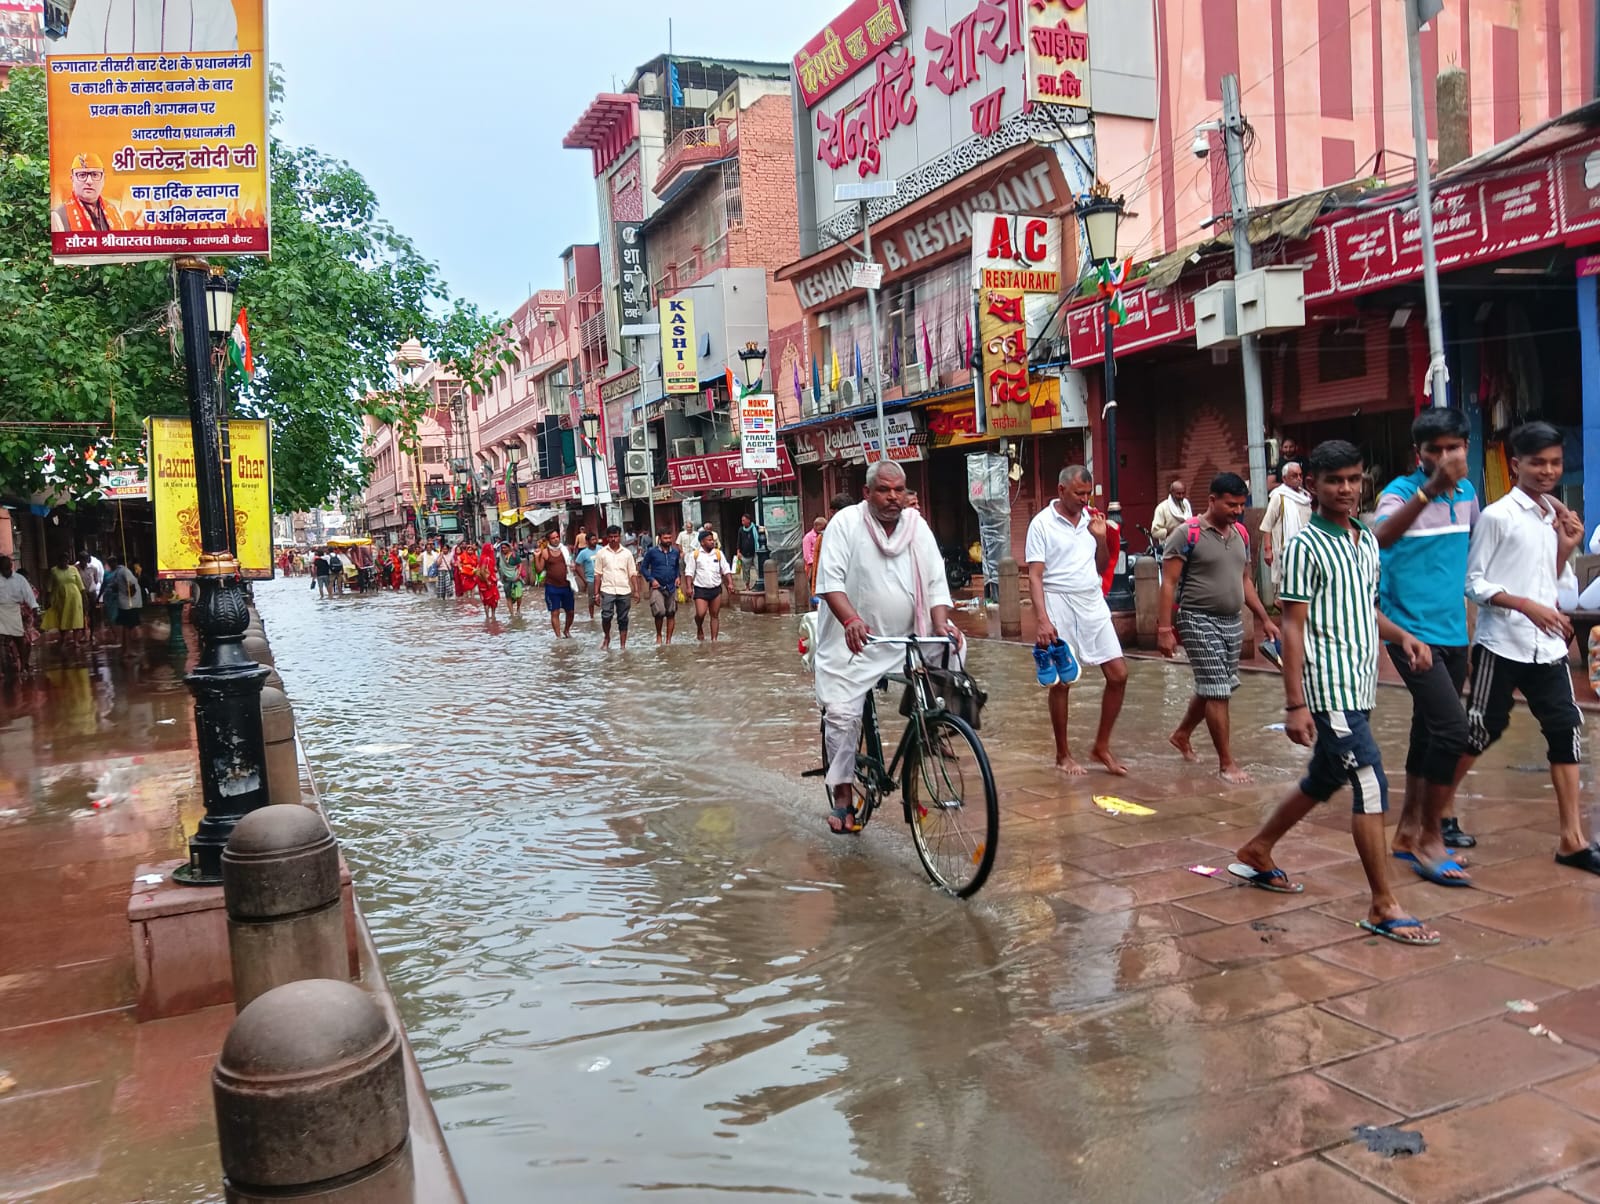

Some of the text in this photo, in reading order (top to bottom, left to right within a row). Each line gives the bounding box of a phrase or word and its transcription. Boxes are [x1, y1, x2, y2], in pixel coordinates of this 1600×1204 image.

[52, 54, 251, 72] लगातार तीसरी बार देश के प्रधानमंत्री
[71, 77, 233, 94] व काशी के सांसद बनने के बाद
[90, 101, 215, 117] प्रथम काशी आगमन पर
[132, 124, 235, 140] आदरणीय प्रधानमंत्री
[113, 144, 257, 170] श्री नरेन्द्र मोदी जी
[132, 182, 239, 200] का हार्दिक स्वागत
[146, 206, 226, 223] व अभिनन्दन
[65, 236, 97, 248] सौरभ
[102, 234, 151, 248] श्रीवास्तव
[194, 234, 229, 245] वाराणसी
[795, 255, 859, 309] KESHAR
[985, 270, 1057, 290] RESTAURANT
[669, 301, 687, 360] KASHI
[747, 399, 769, 408] MONEY
[743, 409, 774, 417] EXCHANGE
[862, 423, 908, 439] TRAV AGENT
[158, 453, 264, 479] Laxmi Ghar
